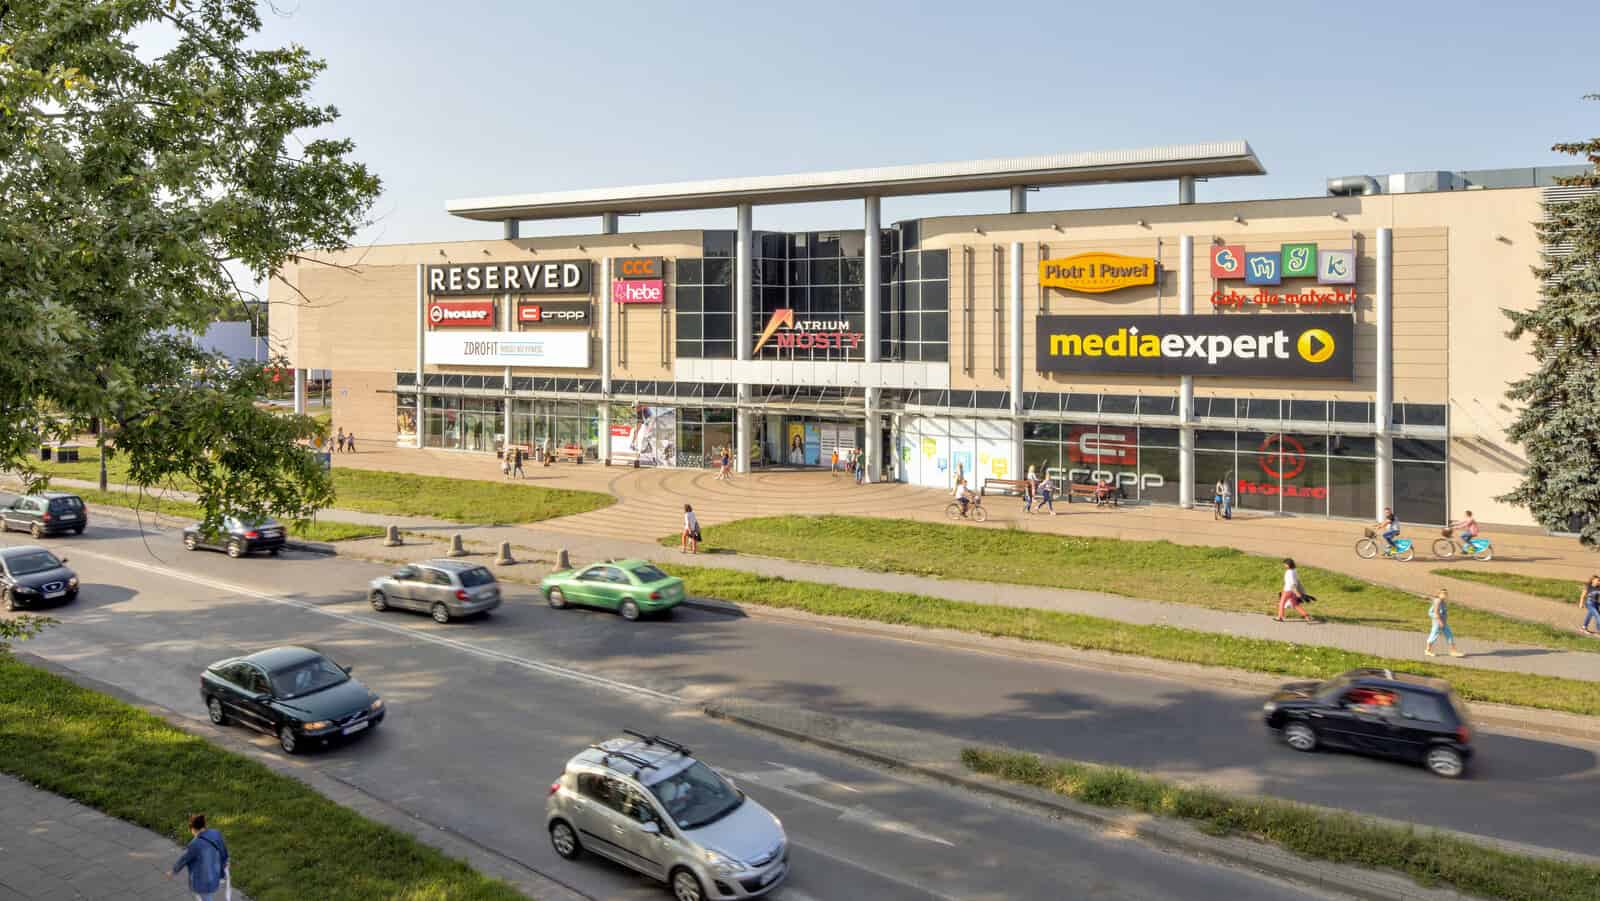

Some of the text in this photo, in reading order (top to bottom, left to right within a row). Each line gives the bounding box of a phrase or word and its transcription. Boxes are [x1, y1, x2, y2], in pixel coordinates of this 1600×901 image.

[430, 263, 581, 290] RESERVED
[1045, 264, 1086, 279] Piotr
[626, 283, 661, 300] hebe
[443, 308, 487, 319] house
[541, 310, 585, 320] cropp
[794, 320, 850, 331] ATRIUM
[463, 341, 498, 356] ZDROFIT
[776, 332, 864, 350] MOSTY
[1050, 325, 1290, 365] mediaexpert
